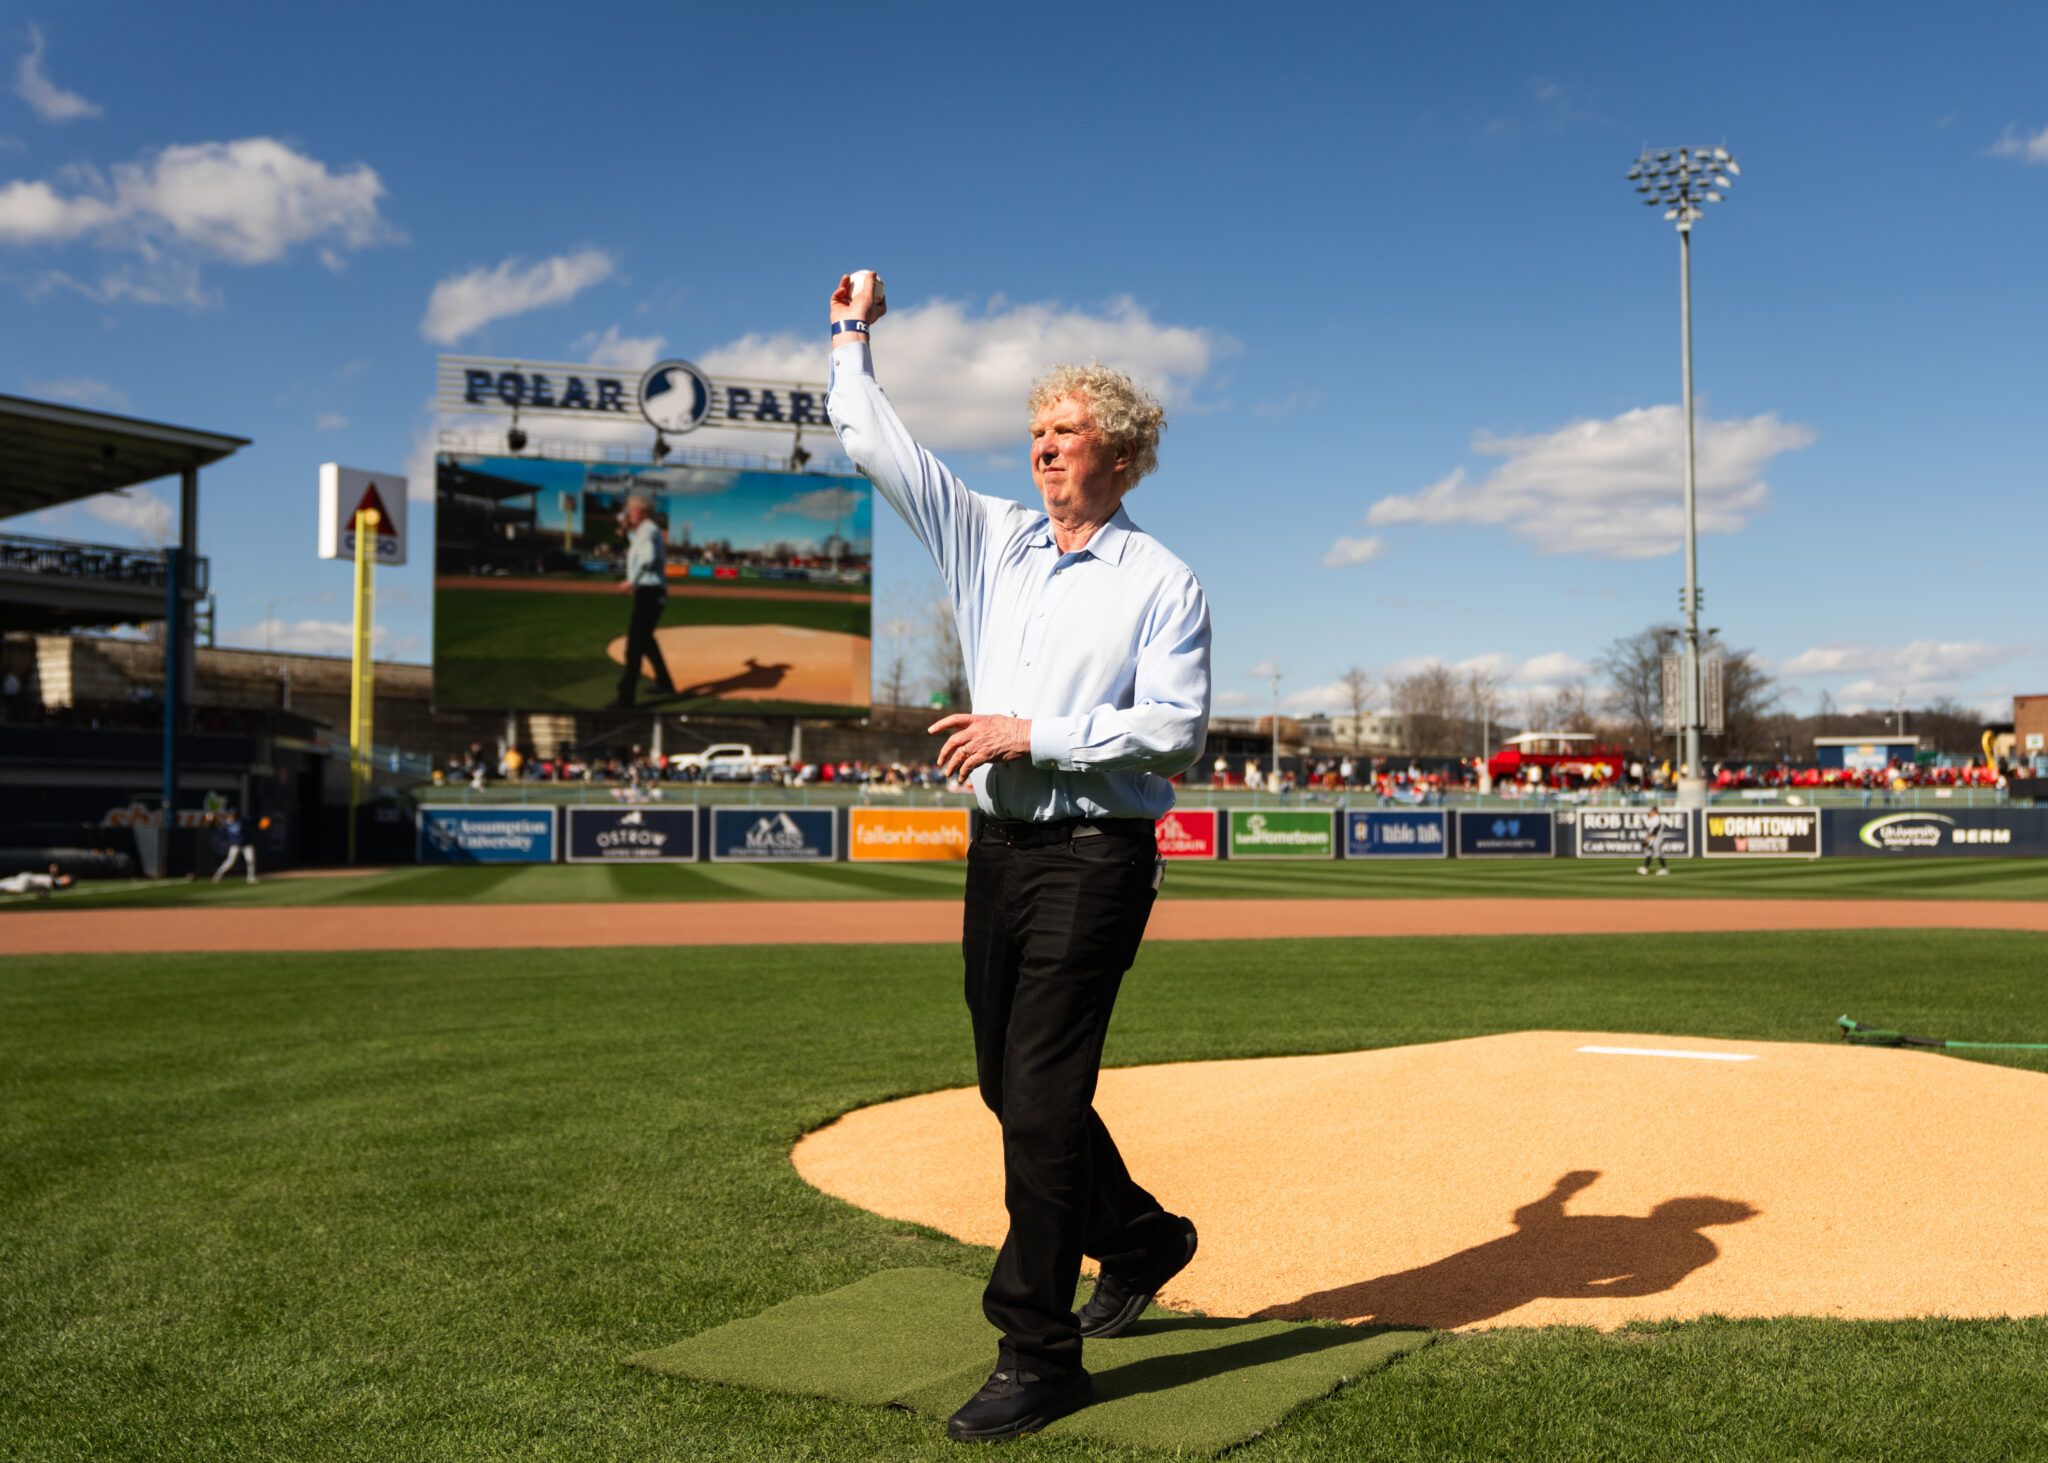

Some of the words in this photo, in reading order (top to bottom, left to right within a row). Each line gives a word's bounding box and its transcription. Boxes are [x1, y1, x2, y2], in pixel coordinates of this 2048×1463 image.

[465, 369, 626, 412] POLAR
[461, 819, 547, 837] Assumption
[1584, 813, 1622, 829] ROB
[1623, 813, 1684, 829] LEVNE
[1709, 816, 1809, 837] WORMTOWN
[596, 829, 667, 847] OSTROW
[856, 824, 964, 845] fallonhealth
[1952, 828, 2011, 844] BERM
[458, 836, 531, 852] University
